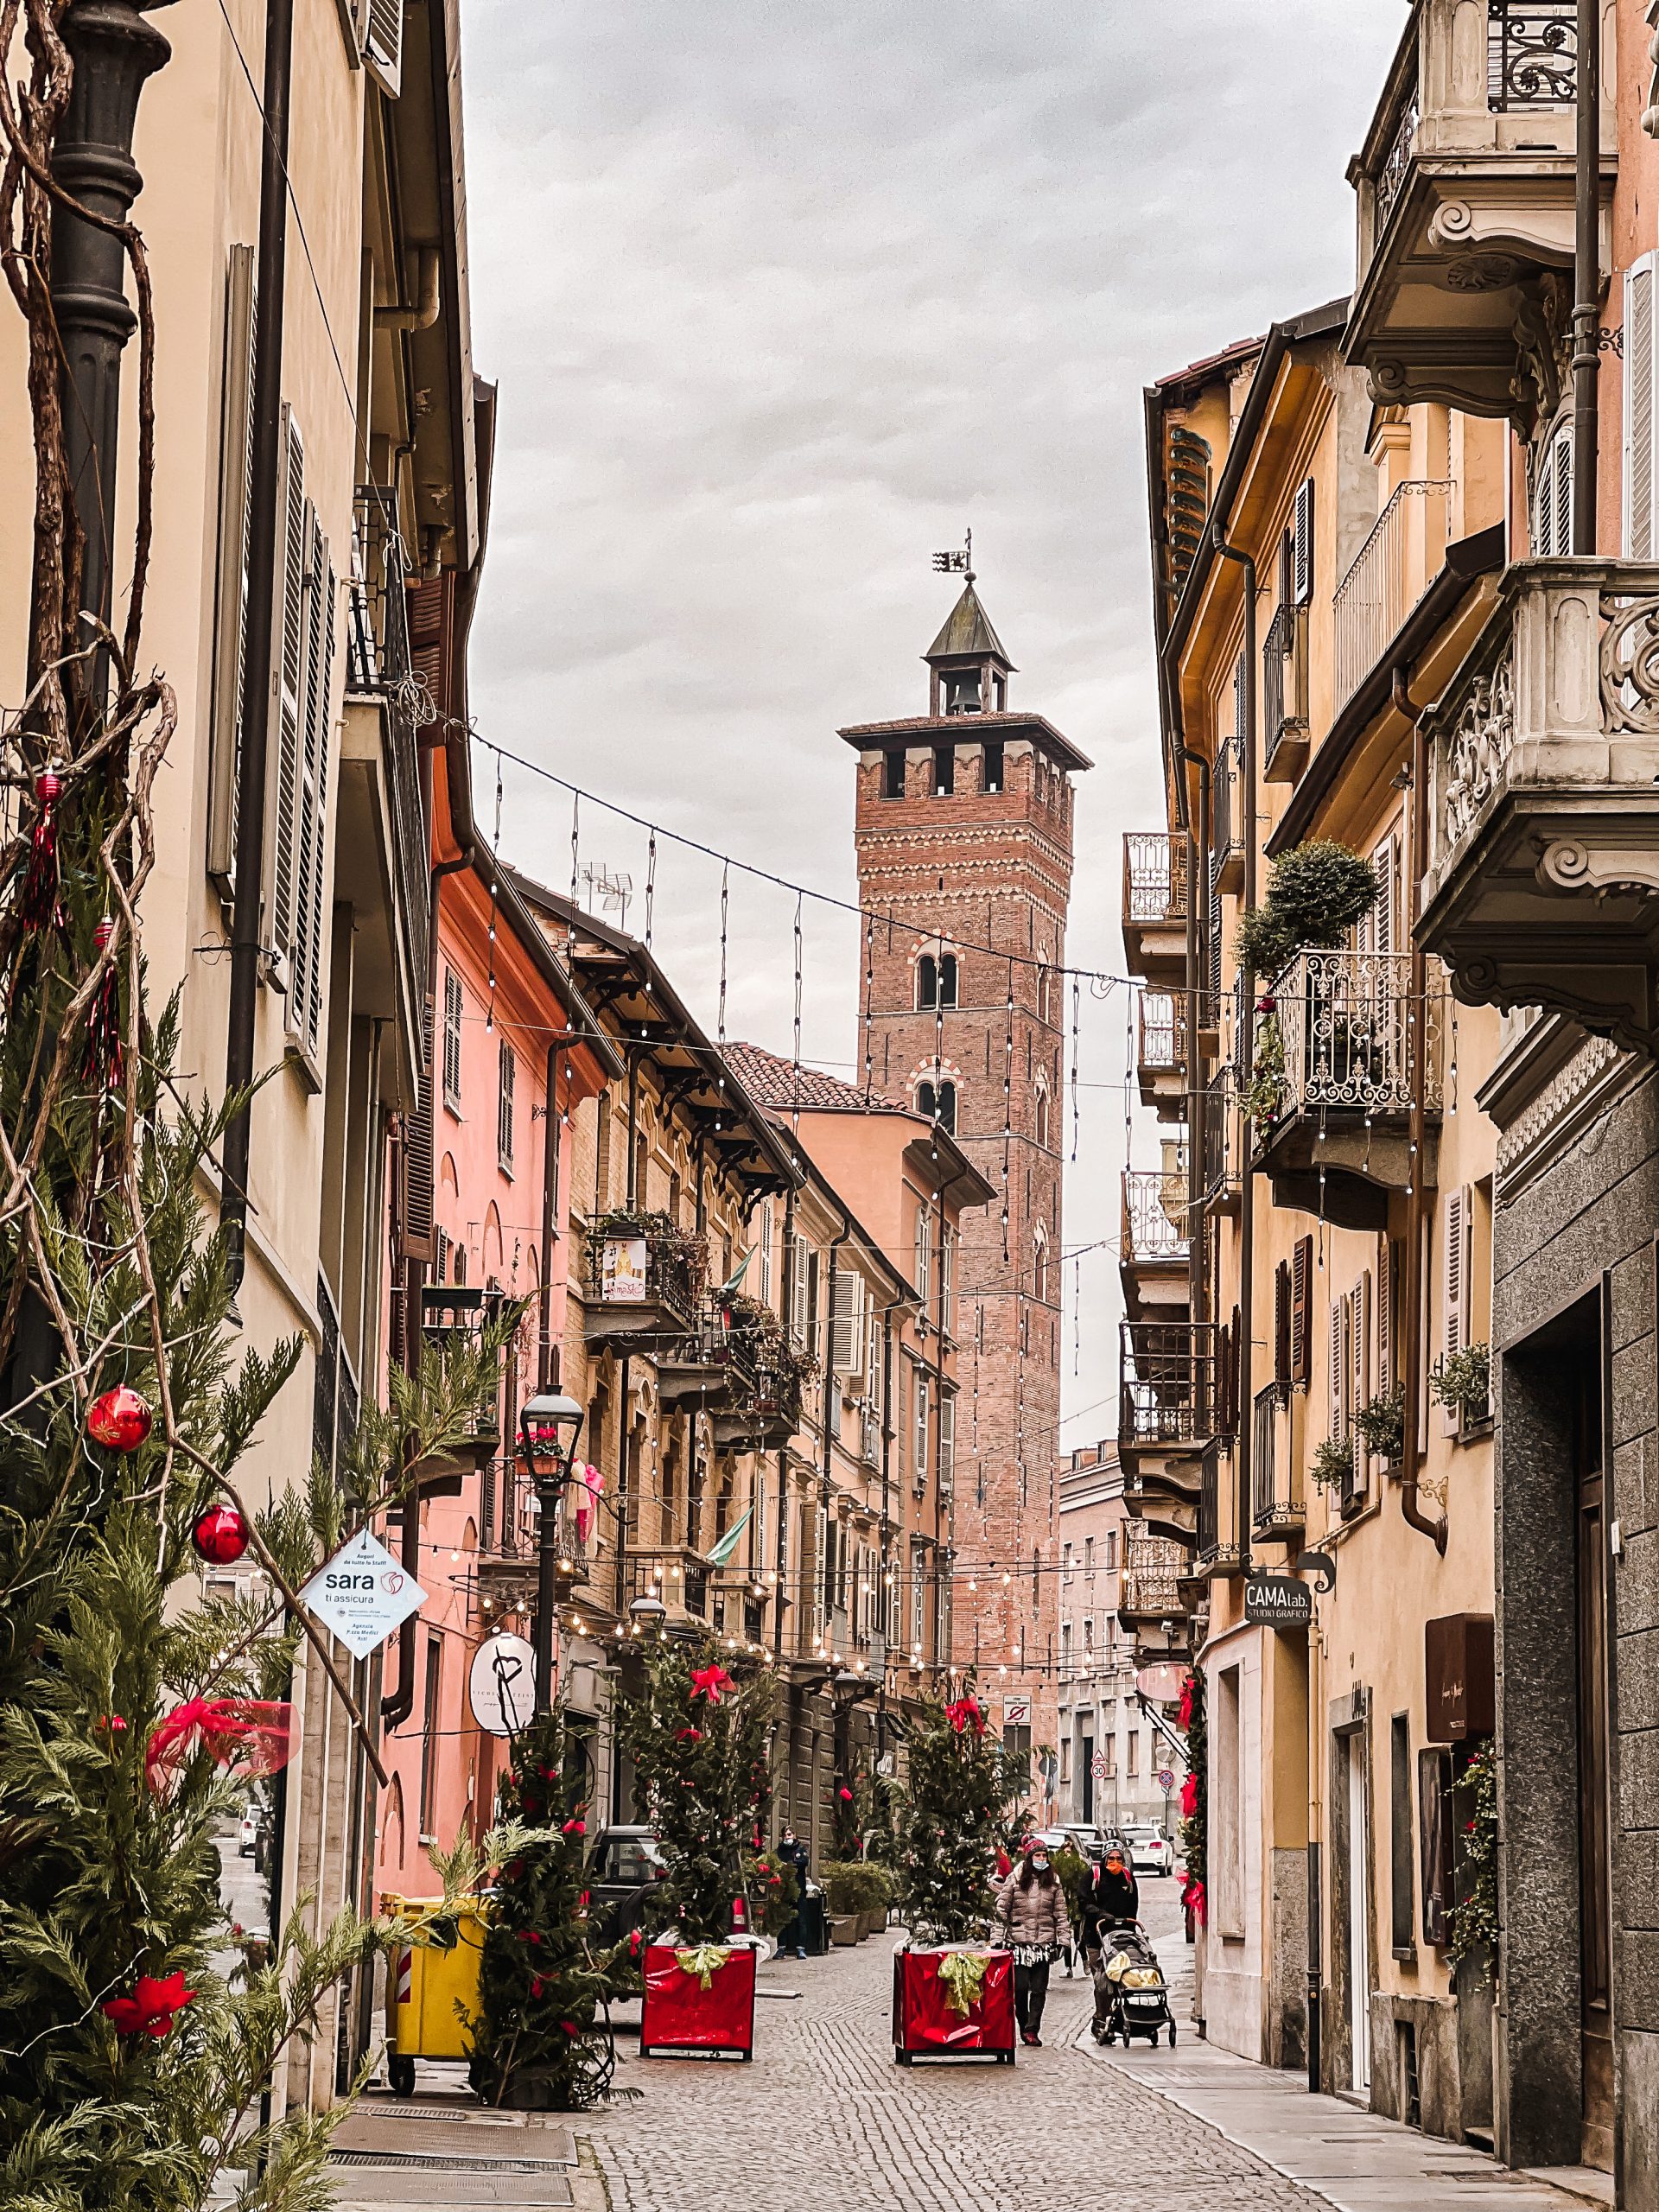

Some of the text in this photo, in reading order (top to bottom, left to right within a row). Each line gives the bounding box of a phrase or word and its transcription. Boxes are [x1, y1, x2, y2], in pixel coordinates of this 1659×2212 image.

[325, 1573, 374, 1590] sara
[334, 1594, 374, 1604] assicura
[1248, 1608, 1308, 1618] STUDIO GRAFICO
